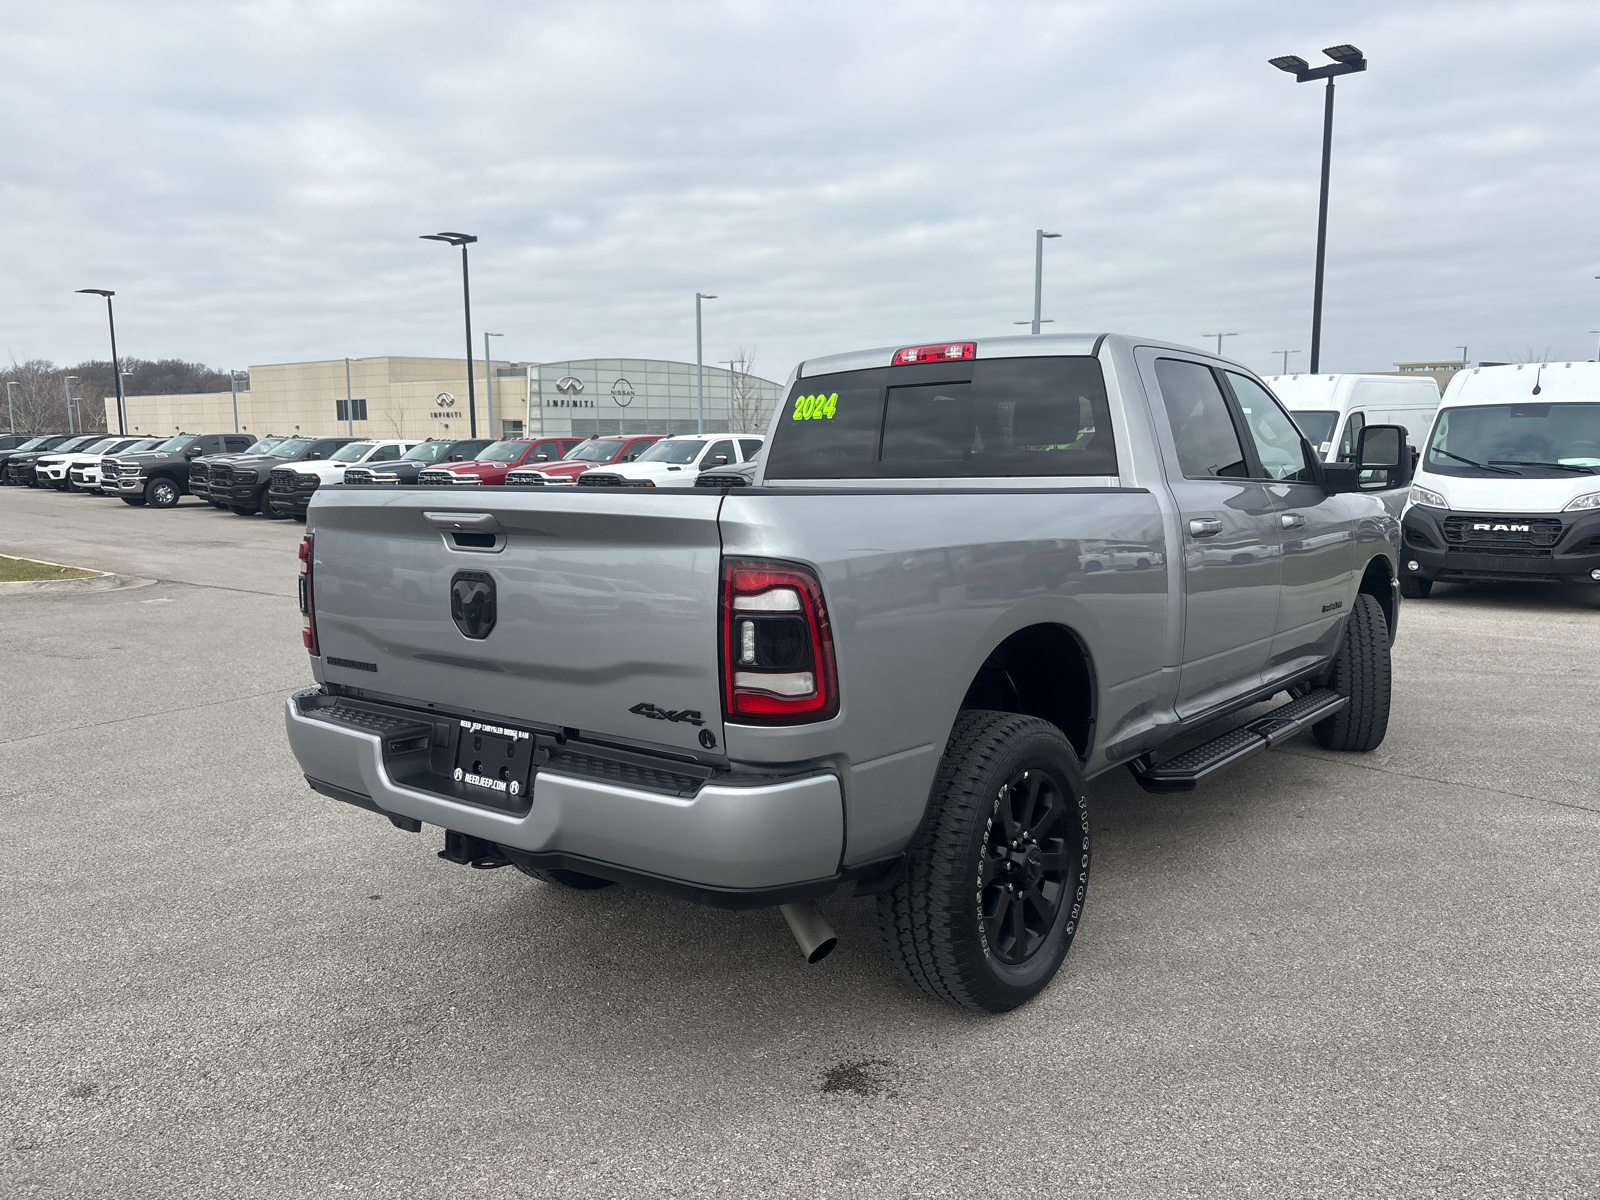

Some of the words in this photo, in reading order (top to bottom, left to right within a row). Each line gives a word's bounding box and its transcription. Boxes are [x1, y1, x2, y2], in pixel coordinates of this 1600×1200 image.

[546, 400, 594, 408] INFINITI
[793, 393, 838, 420] 2024
[430, 411, 462, 419] INFINITI
[1473, 523, 1529, 532] RAM
[472, 722, 482, 730] JEEP
[482, 724, 503, 734] CHRYSLER
[504, 728, 518, 737] DODGE
[519, 731, 529, 739] RAM
[465, 773, 507, 792] REEDJEEP.COM
